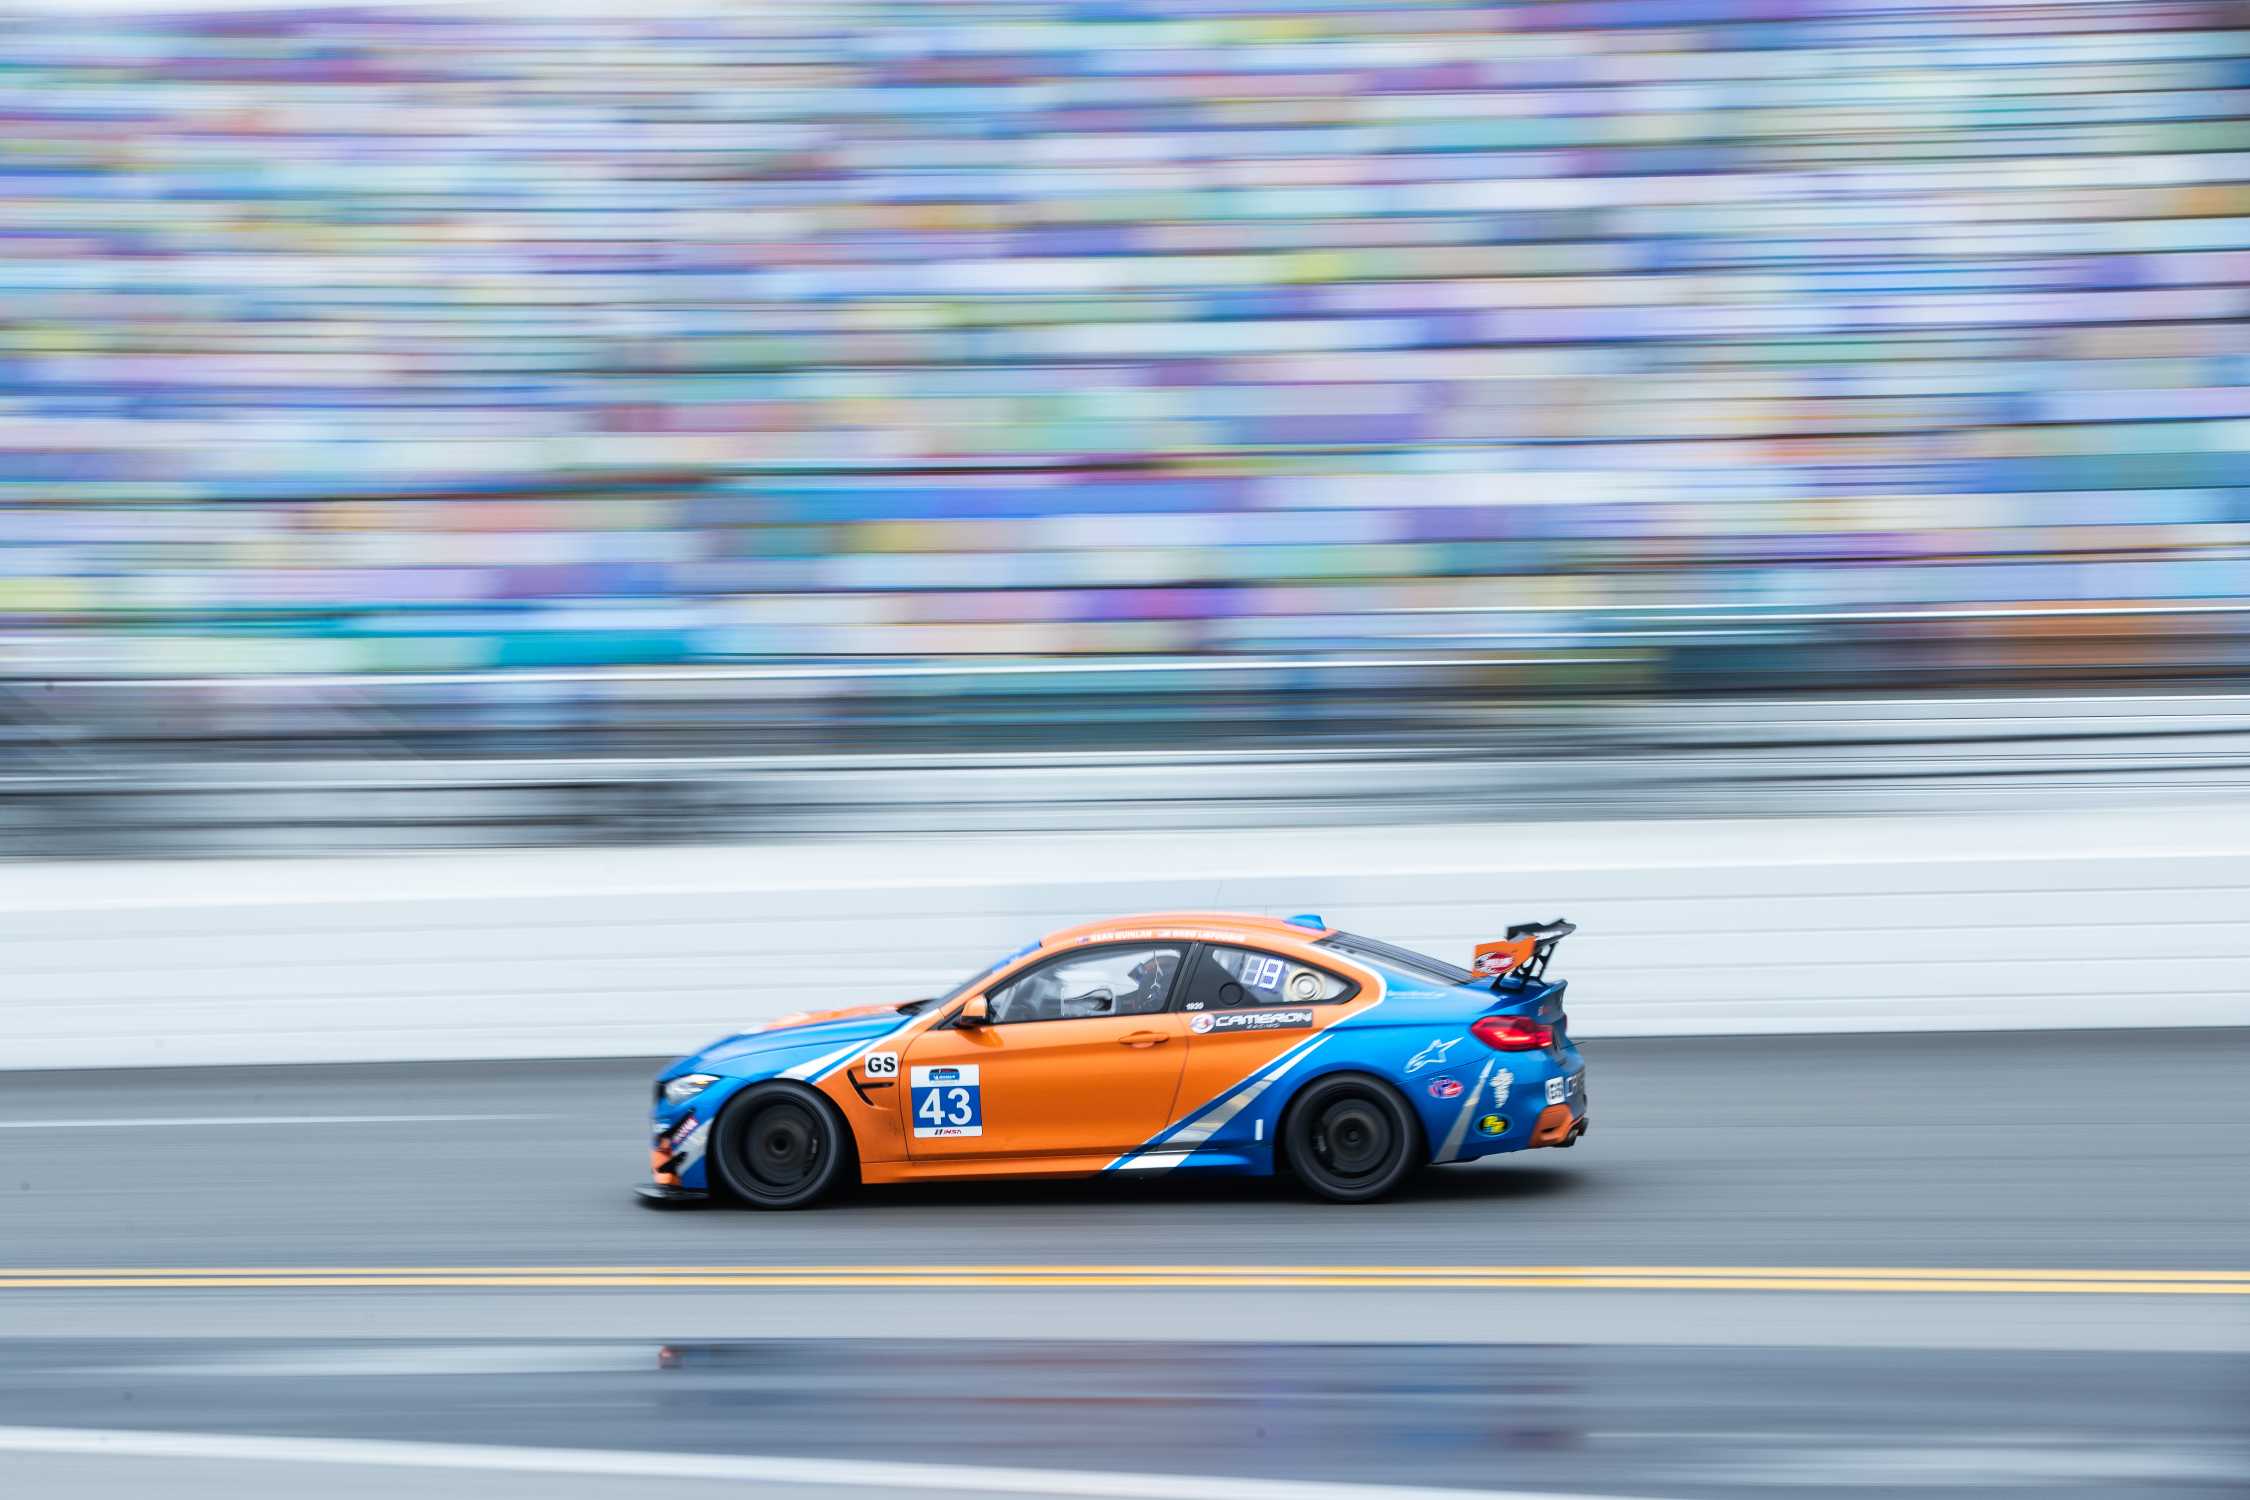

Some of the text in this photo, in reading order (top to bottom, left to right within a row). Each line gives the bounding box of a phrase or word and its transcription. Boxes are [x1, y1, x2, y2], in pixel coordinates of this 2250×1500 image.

[1215, 1012, 1313, 1027] CAMERON
[868, 1057, 896, 1073] GS
[919, 1088, 973, 1126] 43
